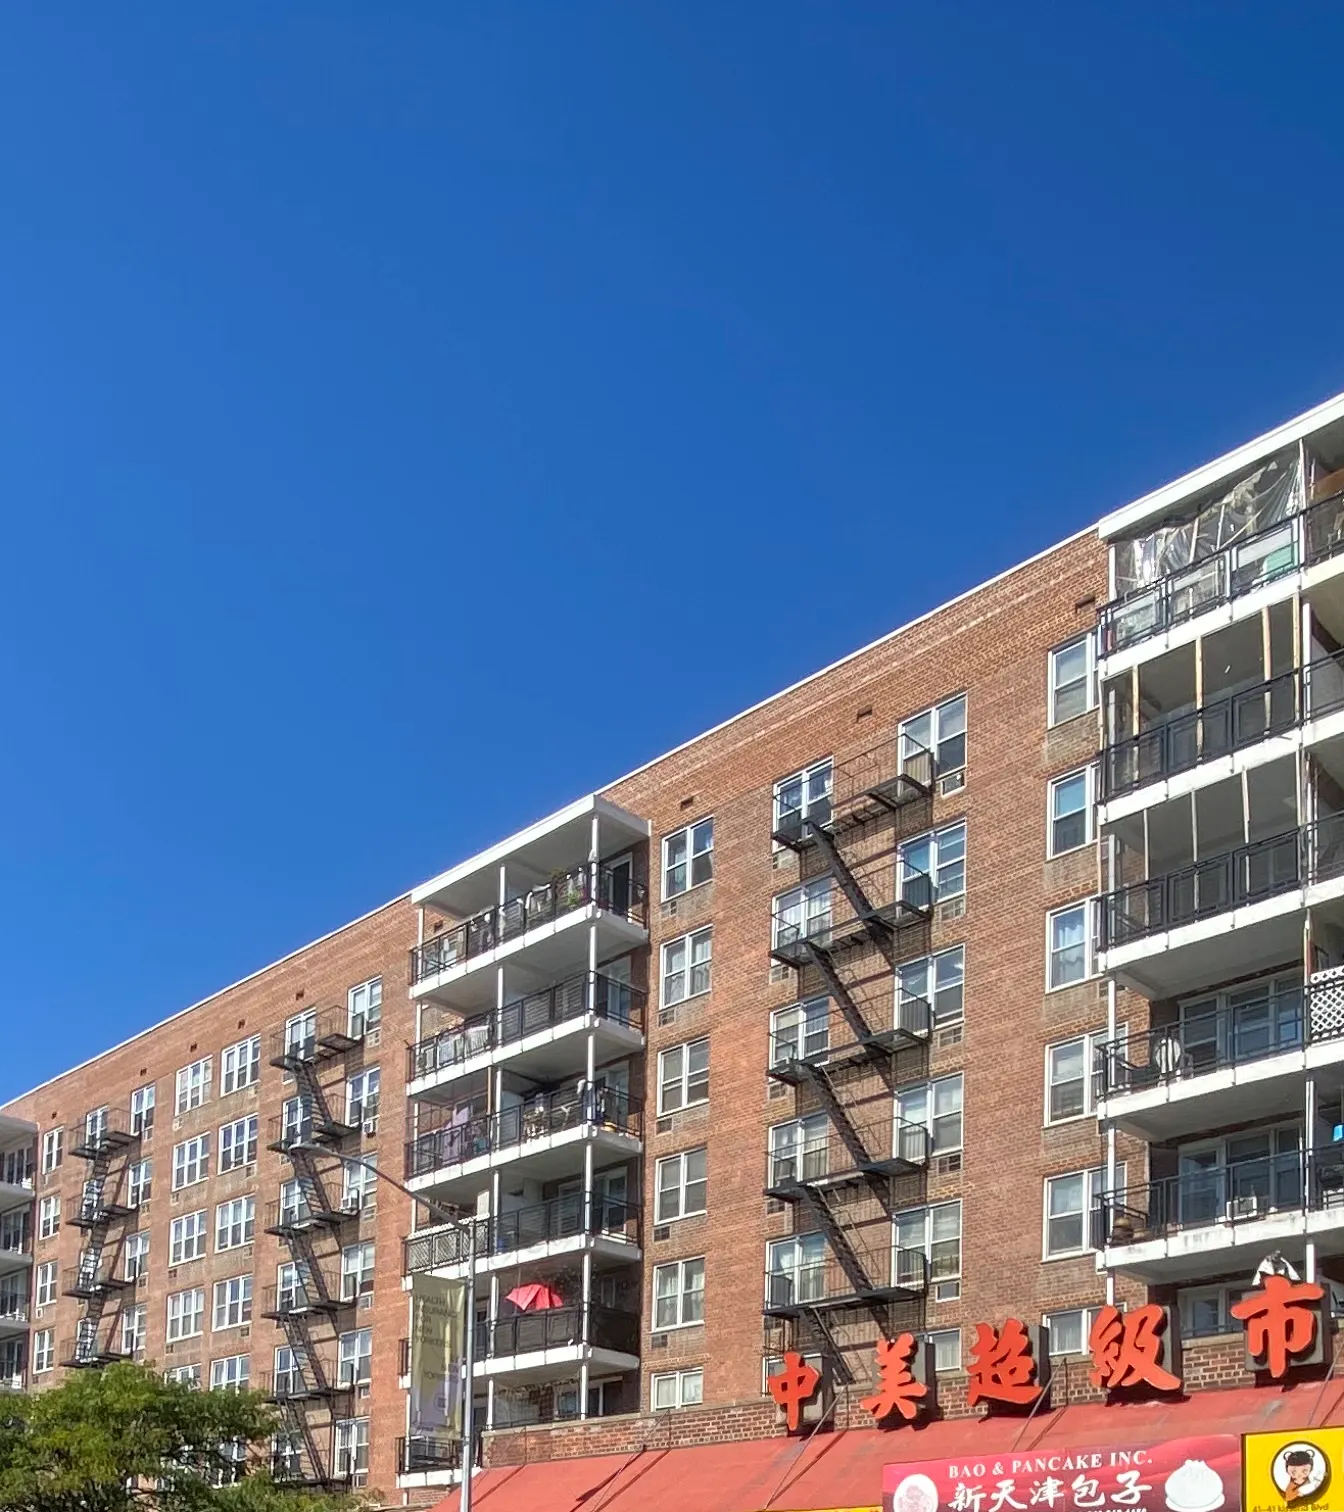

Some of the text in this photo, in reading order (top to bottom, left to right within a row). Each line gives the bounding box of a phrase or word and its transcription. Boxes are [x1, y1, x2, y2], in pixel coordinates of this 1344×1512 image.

[948, 1450, 1153, 1479] BAO & PANCAKE INC.
